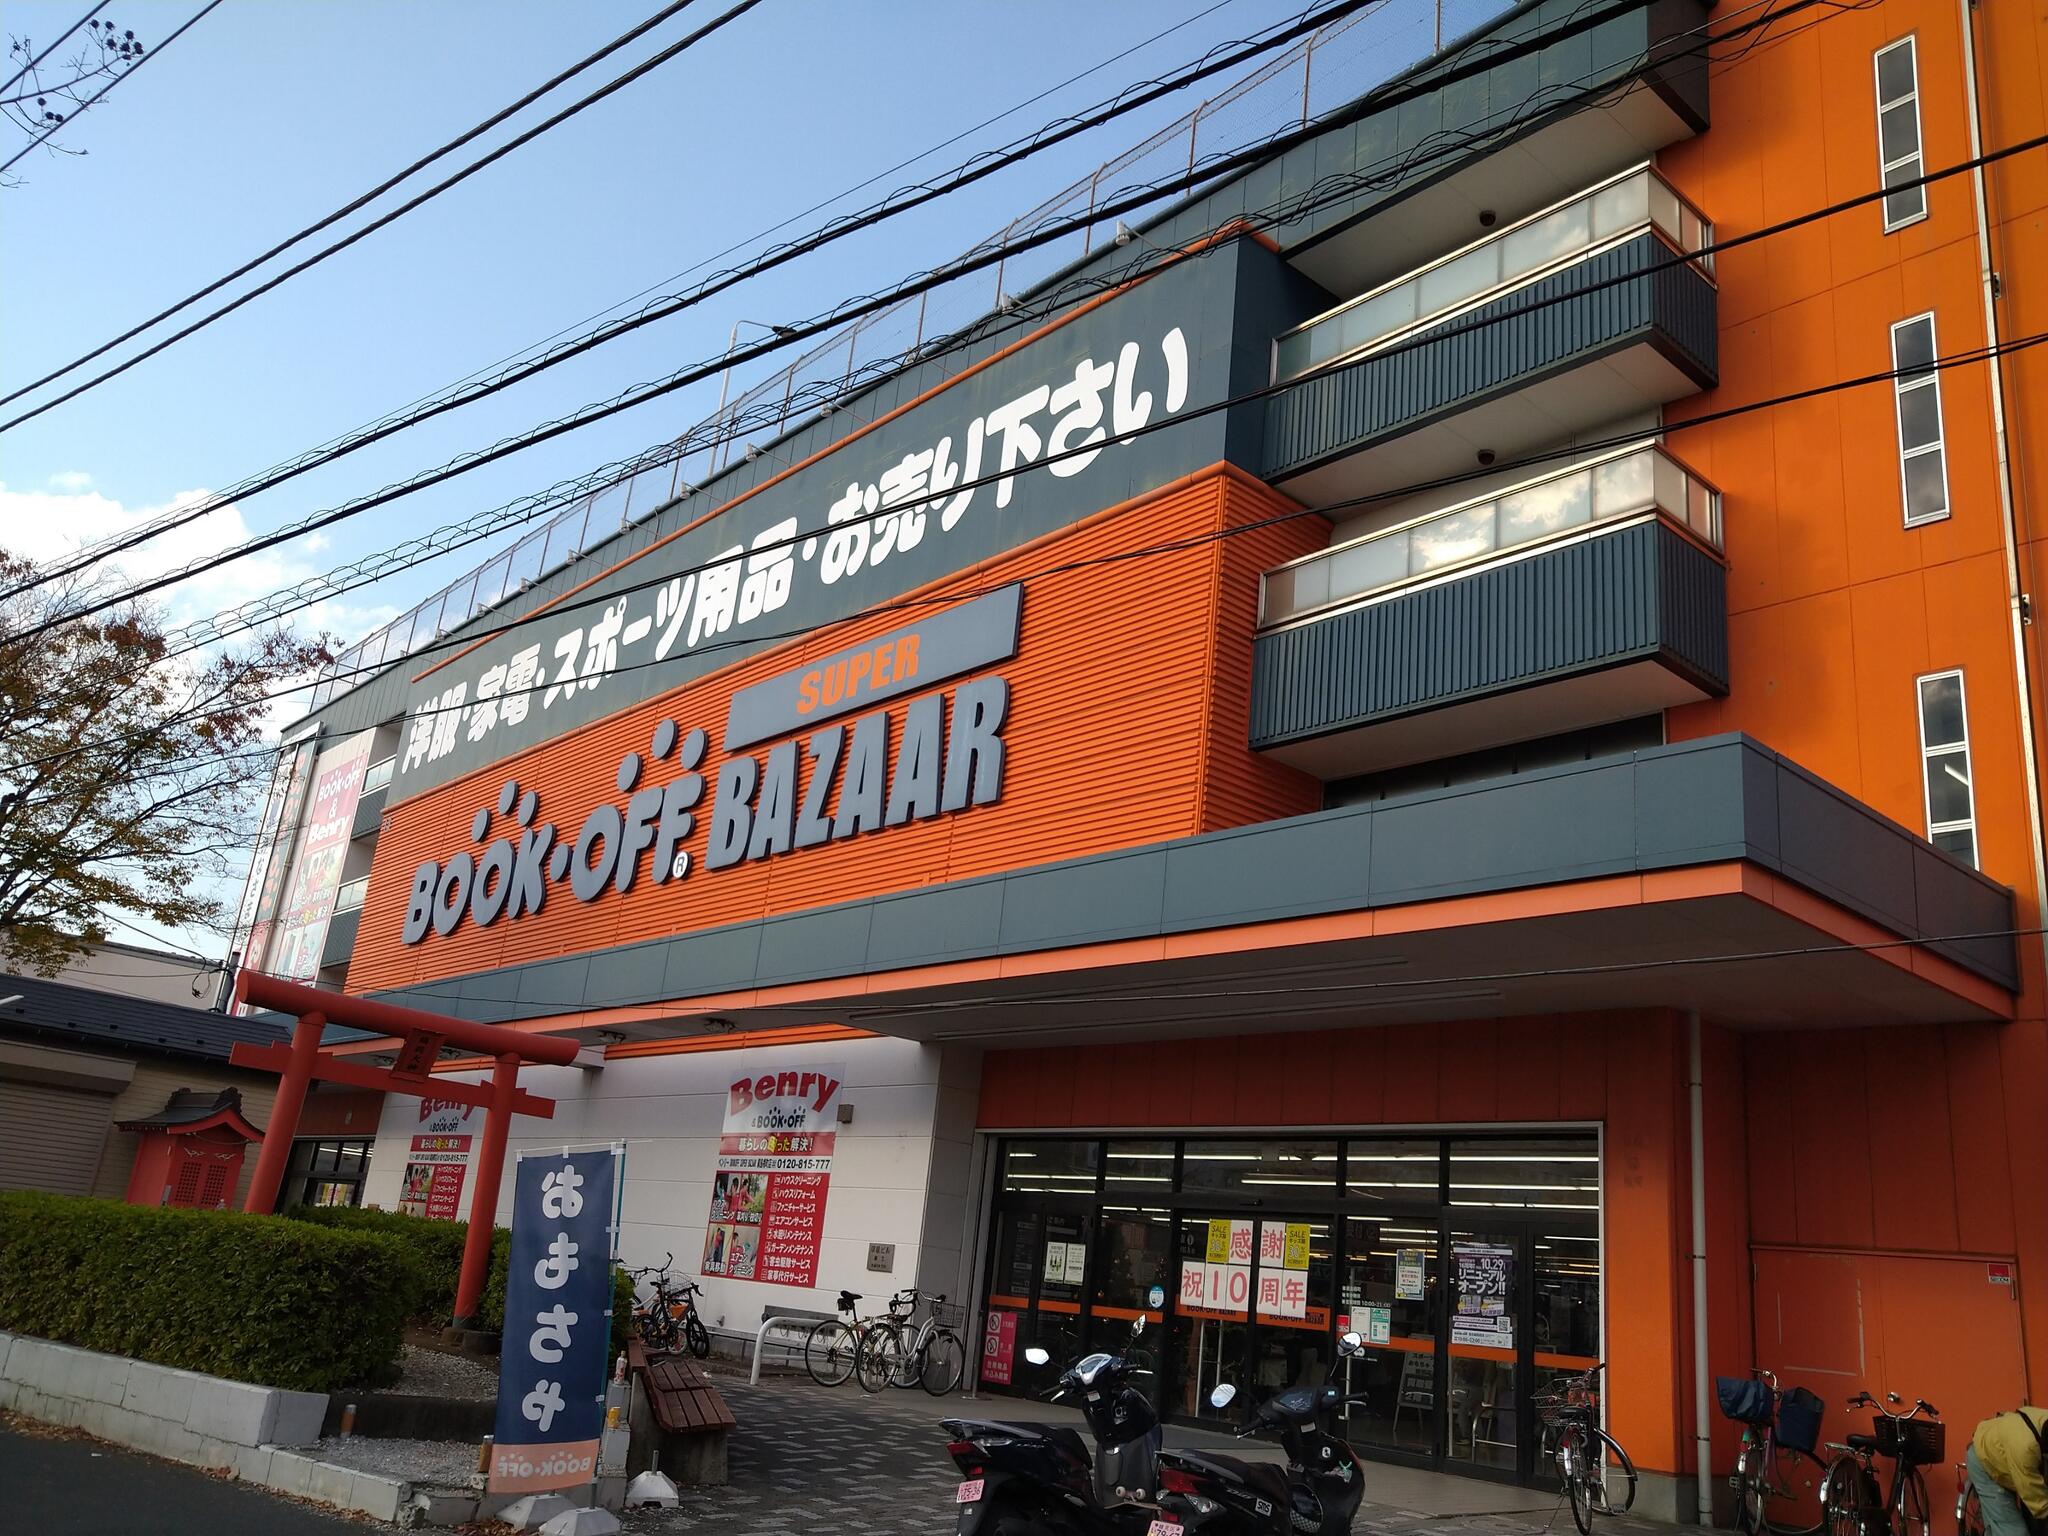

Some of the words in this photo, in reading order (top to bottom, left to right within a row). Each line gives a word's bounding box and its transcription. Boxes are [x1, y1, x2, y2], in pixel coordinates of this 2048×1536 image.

[796, 633, 921, 715] SUPER
[703, 674, 1010, 873] BAZAAR
[328, 797, 338, 819] &
[307, 814, 351, 845] Benry
[729, 1070, 841, 1117] Benry
[776, 1159, 831, 1171] 0120-815-777
[774, 1215, 813, 1227] エアコンサービス
[1230, 1228, 1284, 1260] 感謝
[1182, 1268, 1306, 1310] 祝10周年
[1458, 1269, 1506, 1282] リニューアル
